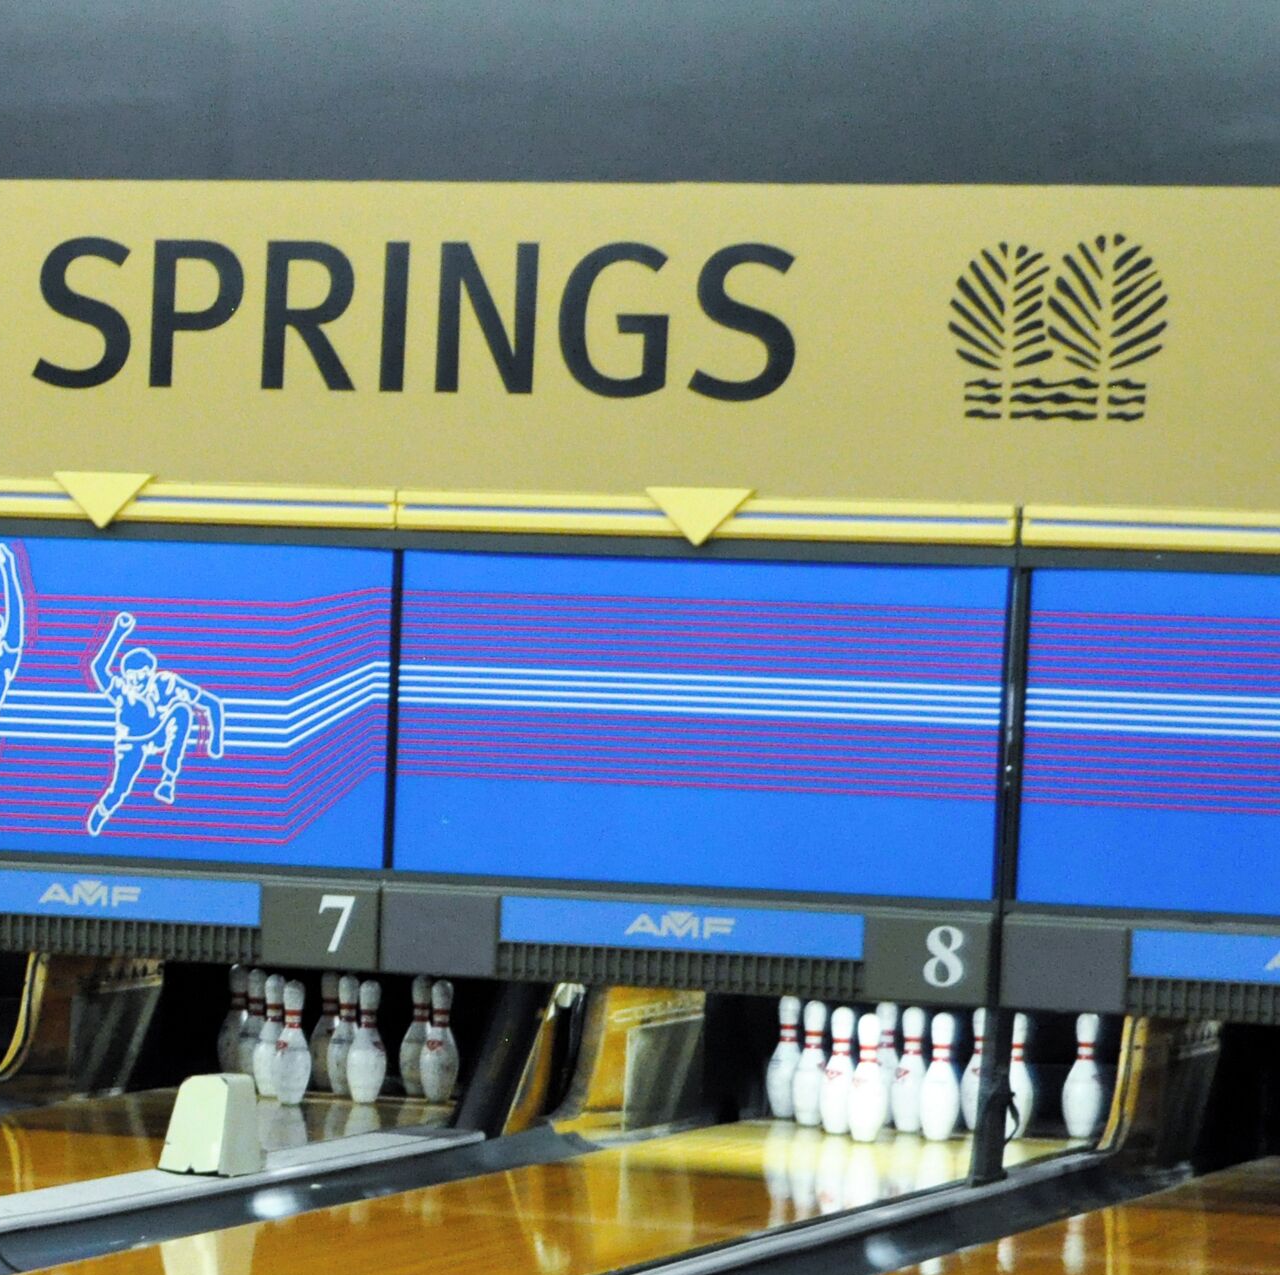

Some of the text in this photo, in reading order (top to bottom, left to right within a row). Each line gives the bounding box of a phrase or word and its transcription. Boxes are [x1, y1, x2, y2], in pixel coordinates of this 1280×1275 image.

[32, 237, 796, 402] SPRINGS
[38, 879, 142, 907] AMF
[318, 895, 356, 953] 7
[624, 911, 735, 939] AMF
[923, 925, 965, 988] 8
